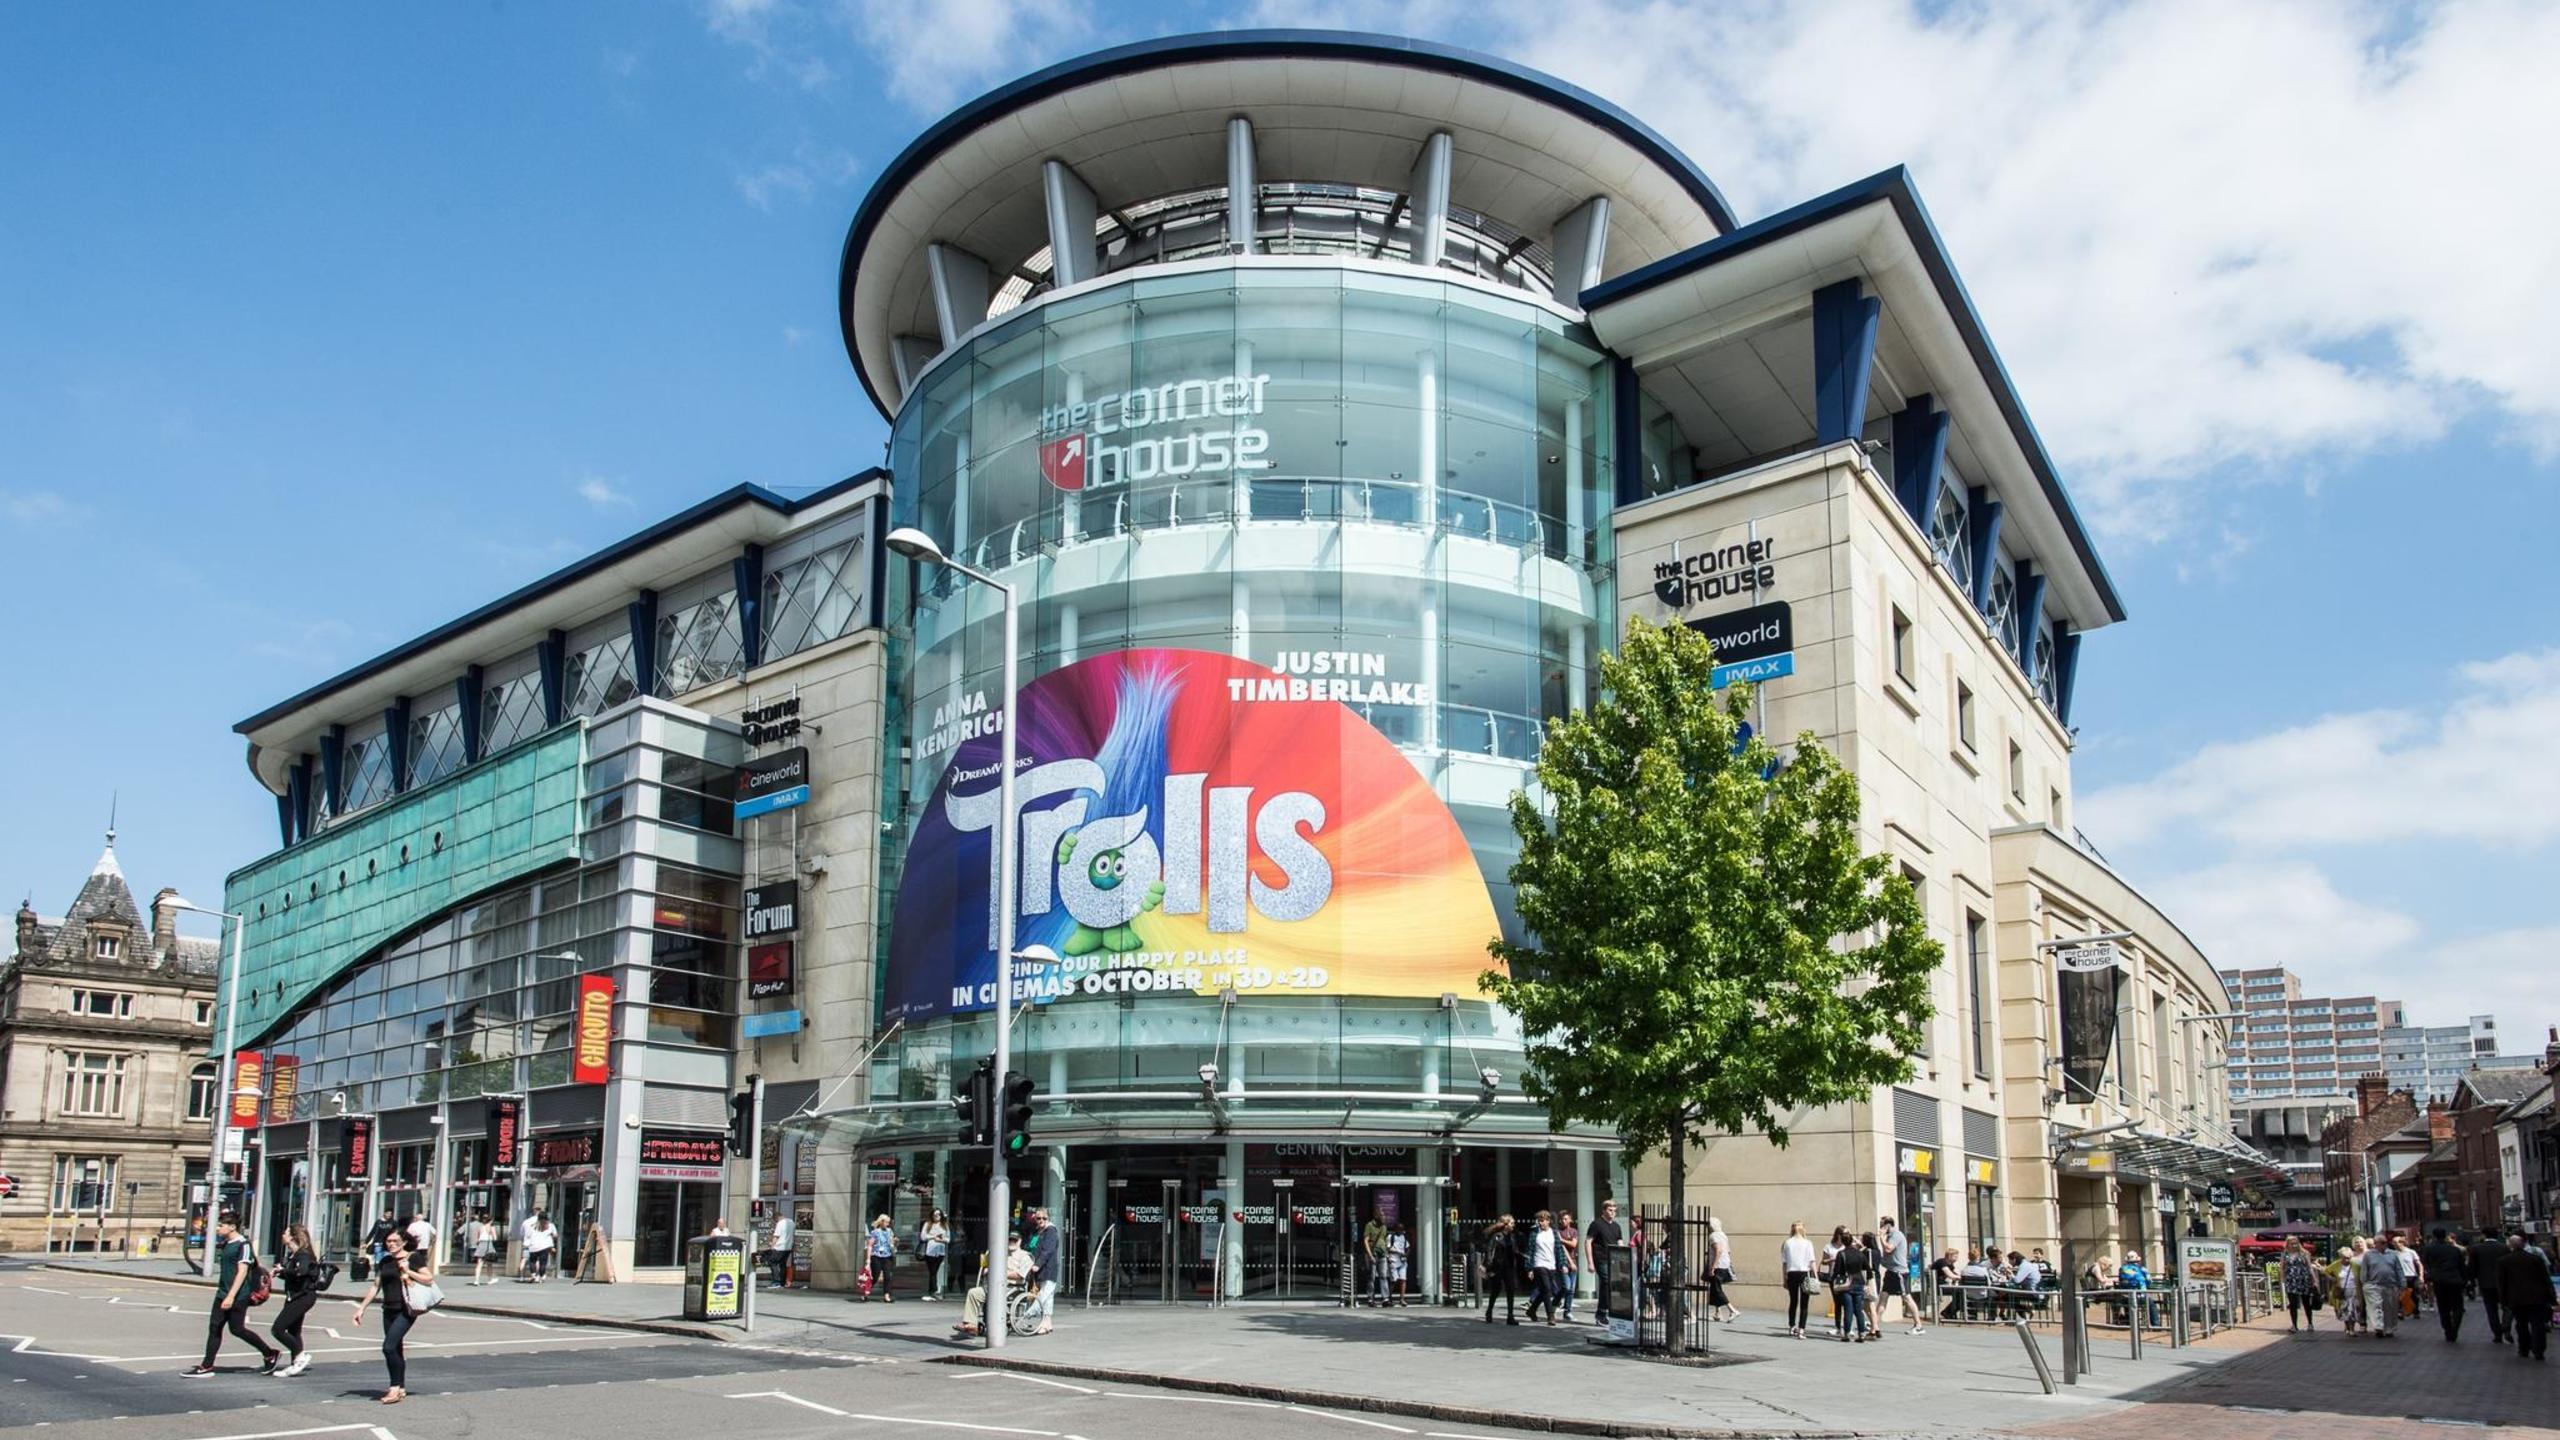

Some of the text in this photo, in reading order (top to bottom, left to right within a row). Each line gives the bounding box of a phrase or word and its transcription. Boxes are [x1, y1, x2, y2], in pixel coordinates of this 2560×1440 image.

[1040, 374, 1270, 435] the corner
[1092, 429, 1269, 488] house
[1654, 538, 1773, 579] the corner
[1685, 565, 1775, 603] house
[1711, 619, 1780, 651] eworld
[1272, 651, 1386, 676] JUSTIN
[1726, 660, 1780, 682] IMAX
[1227, 679, 1430, 705] TIMBERLAKE
[933, 690, 988, 729] ANNA
[750, 761, 800, 787] cineworld
[773, 792, 799, 806] IMAX
[746, 892, 760, 906] The
[746, 903, 792, 935] Forum
[1108, 950, 1176, 970] HAPPY
[1184, 949, 1248, 965] PLACE
[2077, 947, 2110, 957] corner
[2077, 957, 2112, 966] house
[952, 967, 1329, 1007] IN CIEMAS OCTOBER IN 3D & 2D
[580, 991, 609, 1068] CHIQUITO
[1348, 1144, 1406, 1156] CASINO
[1135, 1206, 1164, 1215] corner
[1135, 1215, 1165, 1223] house
[1190, 1206, 1218, 1215] corner
[1190, 1215, 1218, 1223] house
[1244, 1207, 1274, 1215] corner
[1303, 1207, 1334, 1216] corner
[1244, 1215, 1274, 1224] house
[1303, 1215, 1334, 1224] house
[2187, 1246, 2228, 1257] £3 LUNCH
